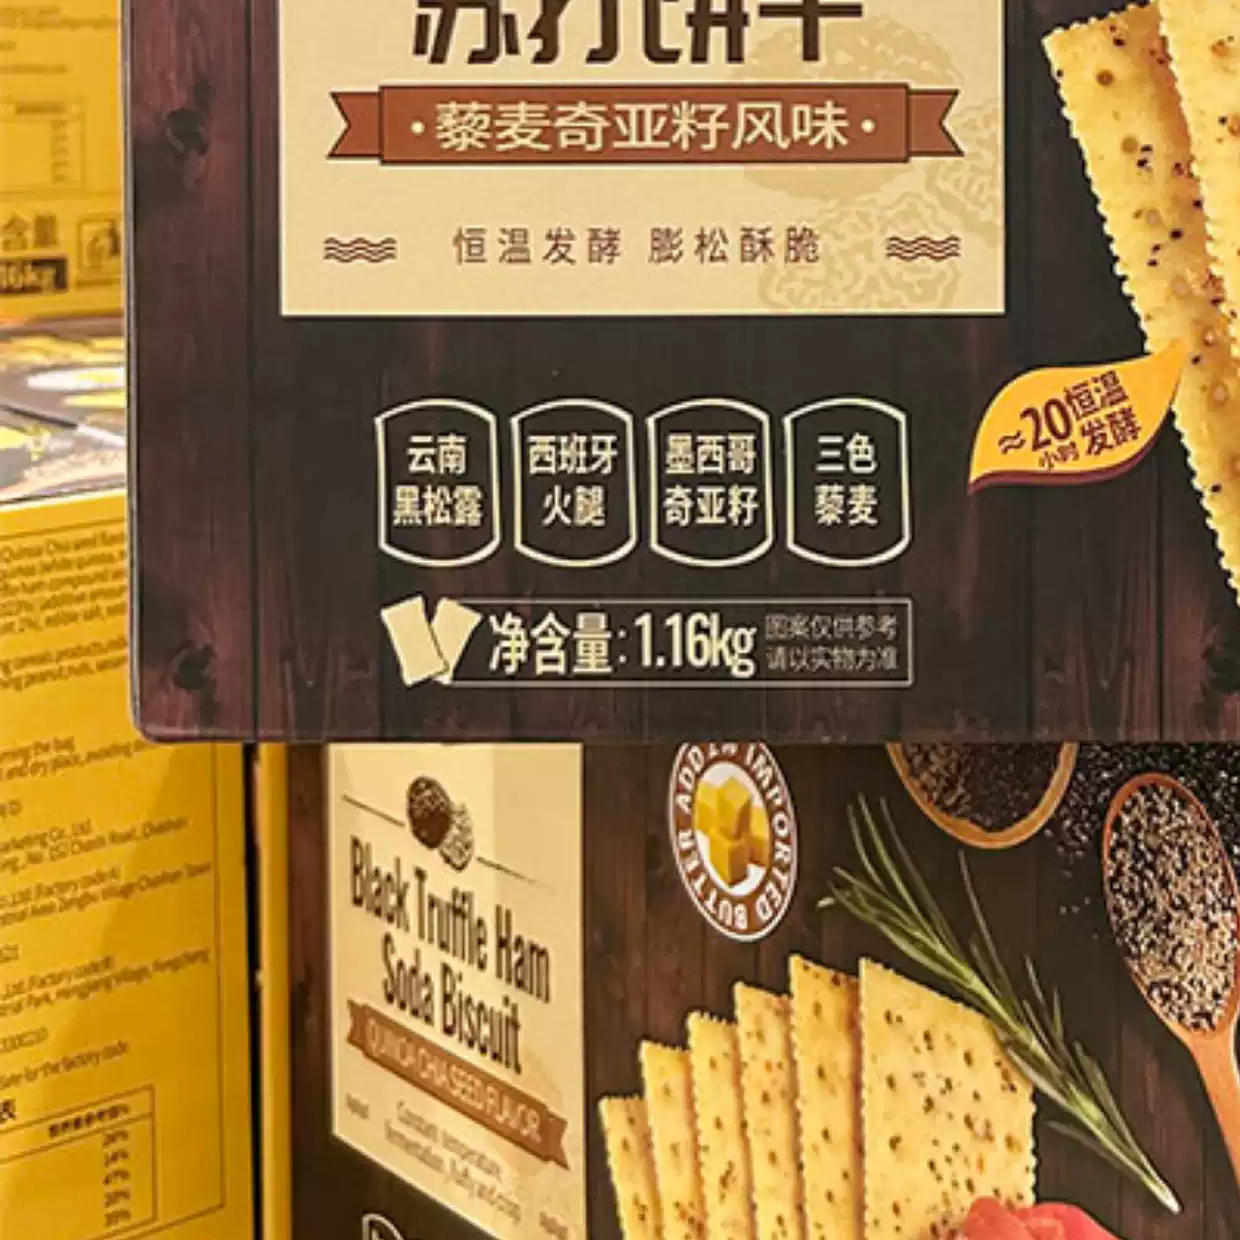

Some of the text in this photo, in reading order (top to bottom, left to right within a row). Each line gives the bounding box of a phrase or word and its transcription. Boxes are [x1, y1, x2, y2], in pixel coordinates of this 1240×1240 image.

[452, 226, 821, 265] 恒温发酵 膨松酥脆
[1063, 370, 1130, 421] 恒温
[1080, 406, 1142, 456] 发酵
[407, 433, 468, 475] 云南
[527, 432, 618, 475] 西班牙
[665, 432, 756, 475] 墨西哥
[815, 432, 878, 475] 三色
[393, 484, 484, 527] 黑松露
[542, 484, 606, 527] 火腿
[663, 484, 759, 527] 奇亚籽
[814, 483, 879, 527] 藜麦
[676, 745, 705, 815] ADD
[350, 834, 551, 1004] Black Truffle Ham
[381, 931, 523, 1076] Soda Biscuit
